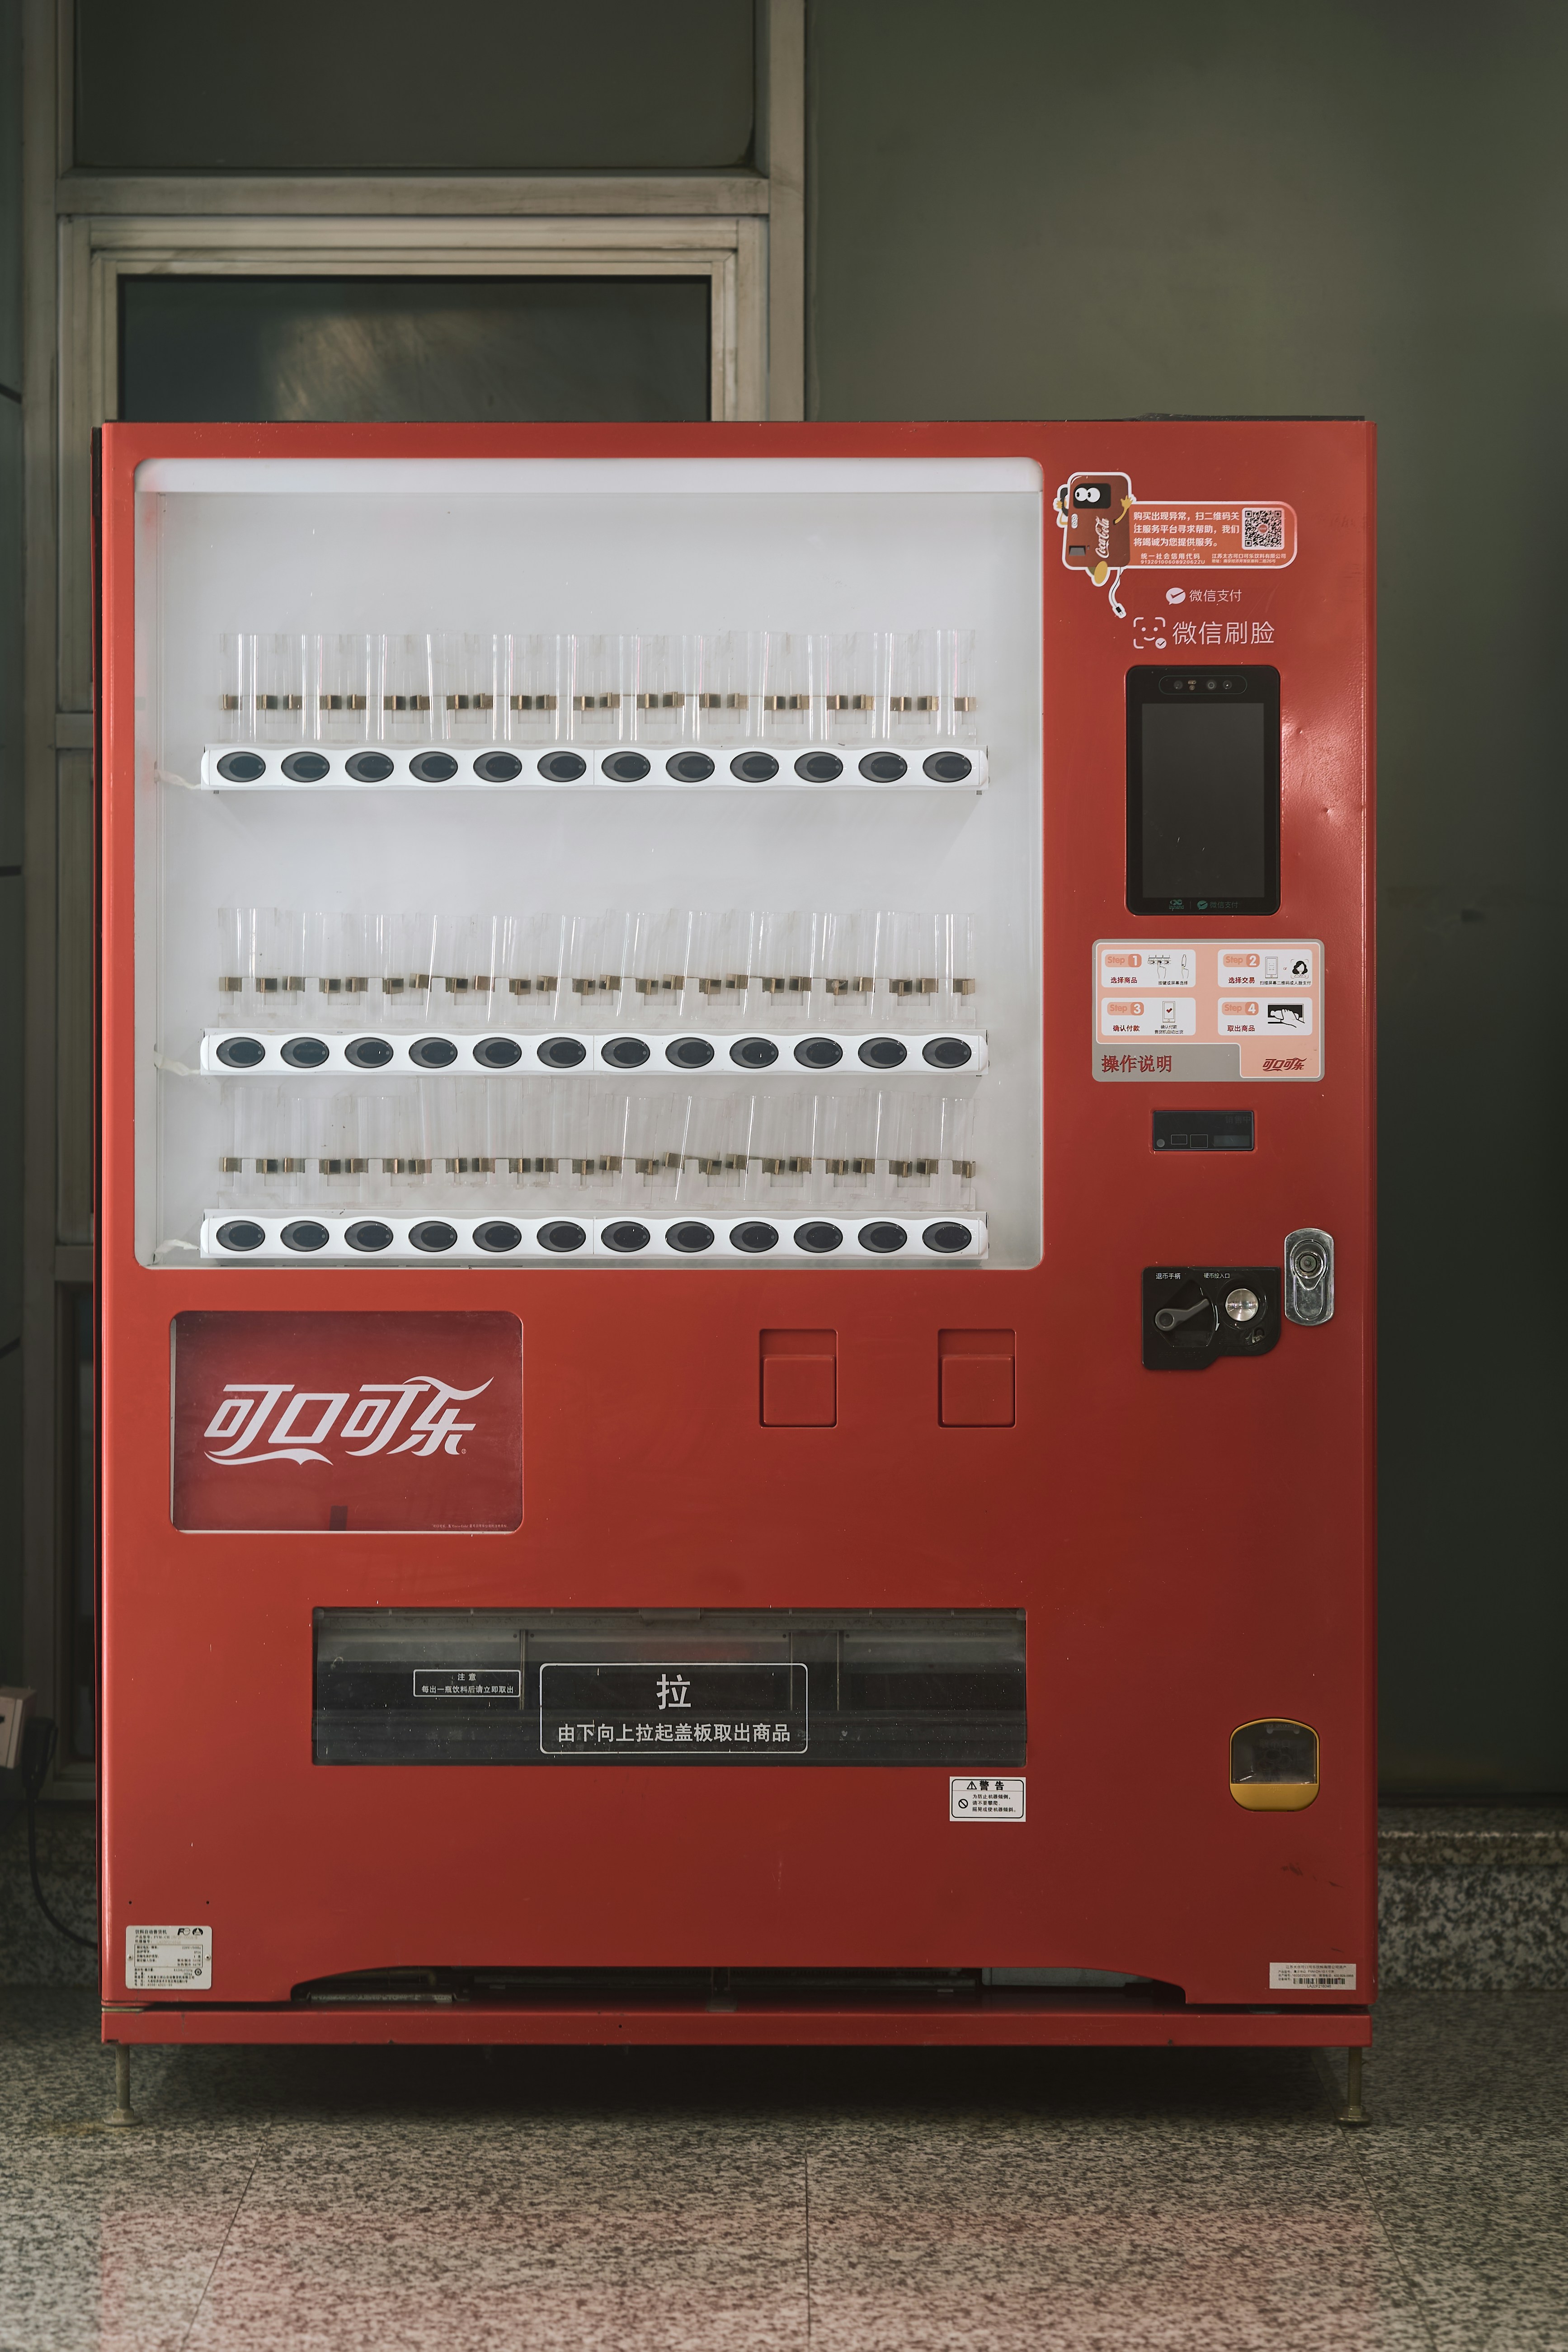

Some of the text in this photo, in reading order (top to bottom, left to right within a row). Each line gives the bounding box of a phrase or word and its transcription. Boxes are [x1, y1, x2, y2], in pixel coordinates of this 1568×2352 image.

[1134, 512, 1240, 522] 购买出现异常，扫二维码关
[1134, 525, 1240, 534] 注服务平台寻求帮助，我们
[1134, 537, 1219, 547] 将竭诚为您提供服务。
[1189, 589, 1242, 602] 微信支付
[1172, 621, 1275, 645] 微信刷脸
[1107, 955, 1138, 966] Step 1
[1225, 955, 1257, 966] Step 2
[1110, 1003, 1141, 1014] Step 3
[1224, 1003, 1256, 1014] Step 4
[1102, 1054, 1172, 1073] 操作说明
[1262, 1057, 1308, 1072] 可口可乐
[204, 1376, 494, 1466] 可口可乐
[421, 1685, 513, 1693] 每出一瓶饮料后请立即取出
[656, 1674, 691, 1710] 拉
[558, 1723, 791, 1742] 由下向上拉起盖板取出商品
[979, 1780, 1004, 1791] 警告
